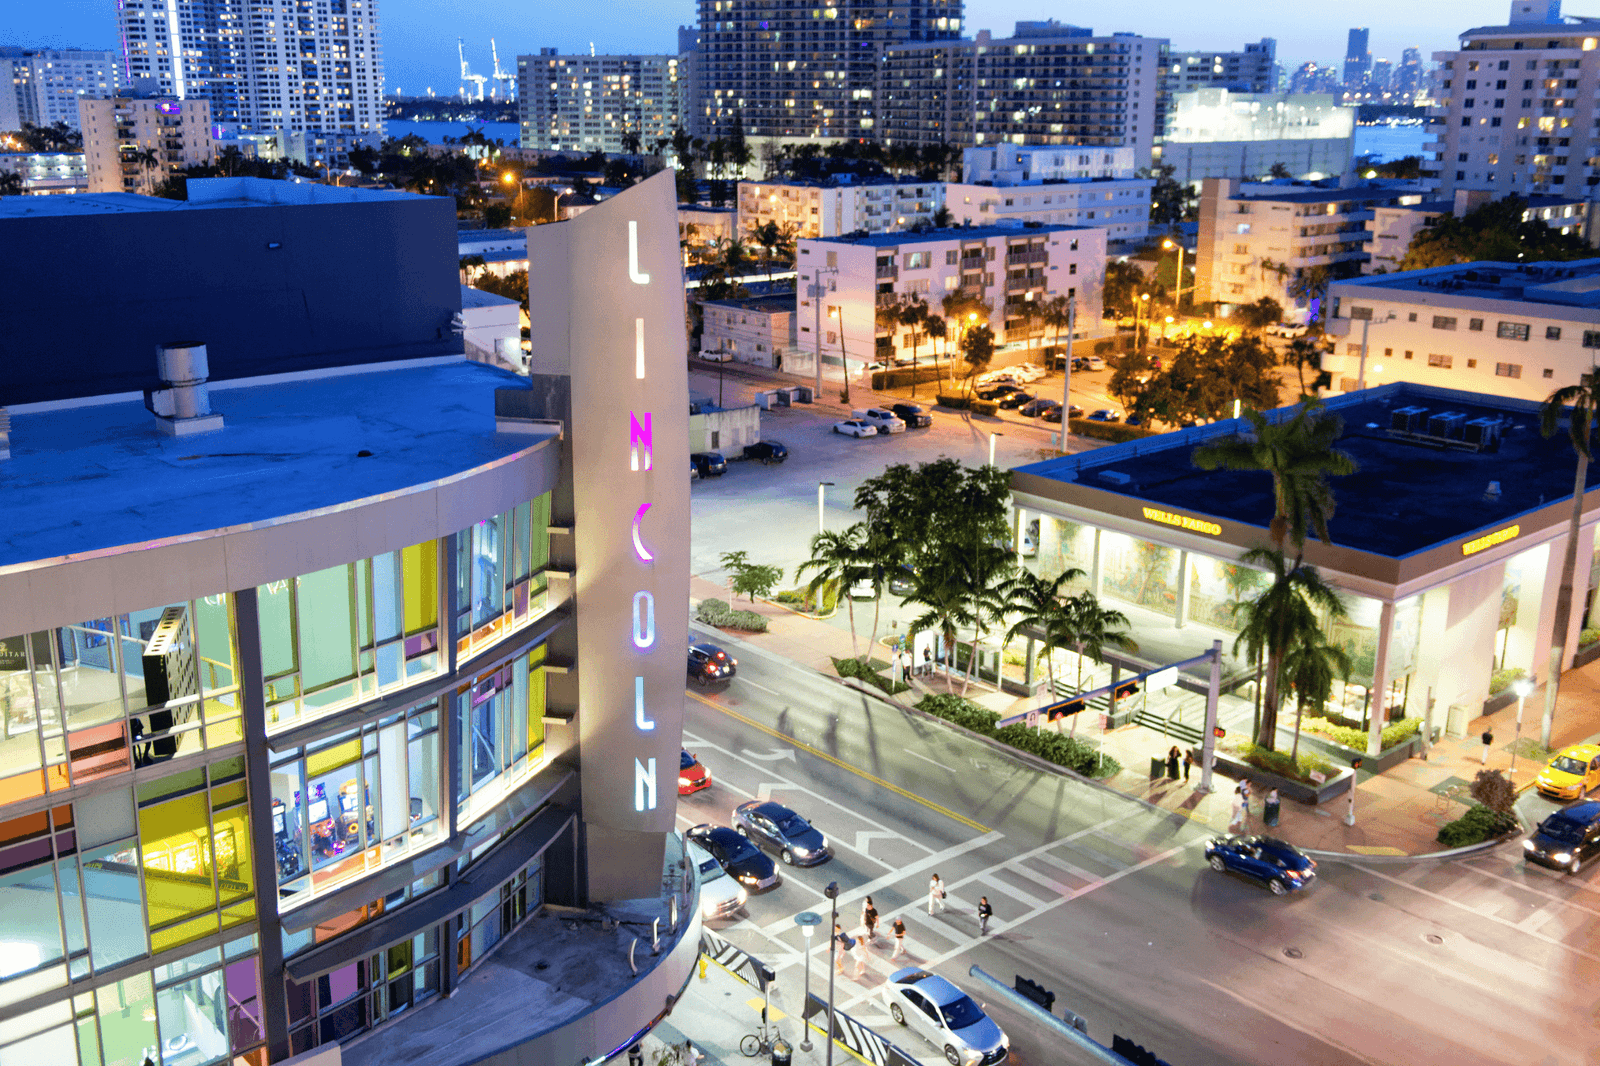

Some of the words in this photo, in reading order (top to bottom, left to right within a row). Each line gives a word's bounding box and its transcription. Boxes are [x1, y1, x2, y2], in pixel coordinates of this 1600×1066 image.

[628, 220, 657, 812] LINCOLN
[1142, 507, 1182, 526] WELLS
[1181, 516, 1222, 536] FARGO
